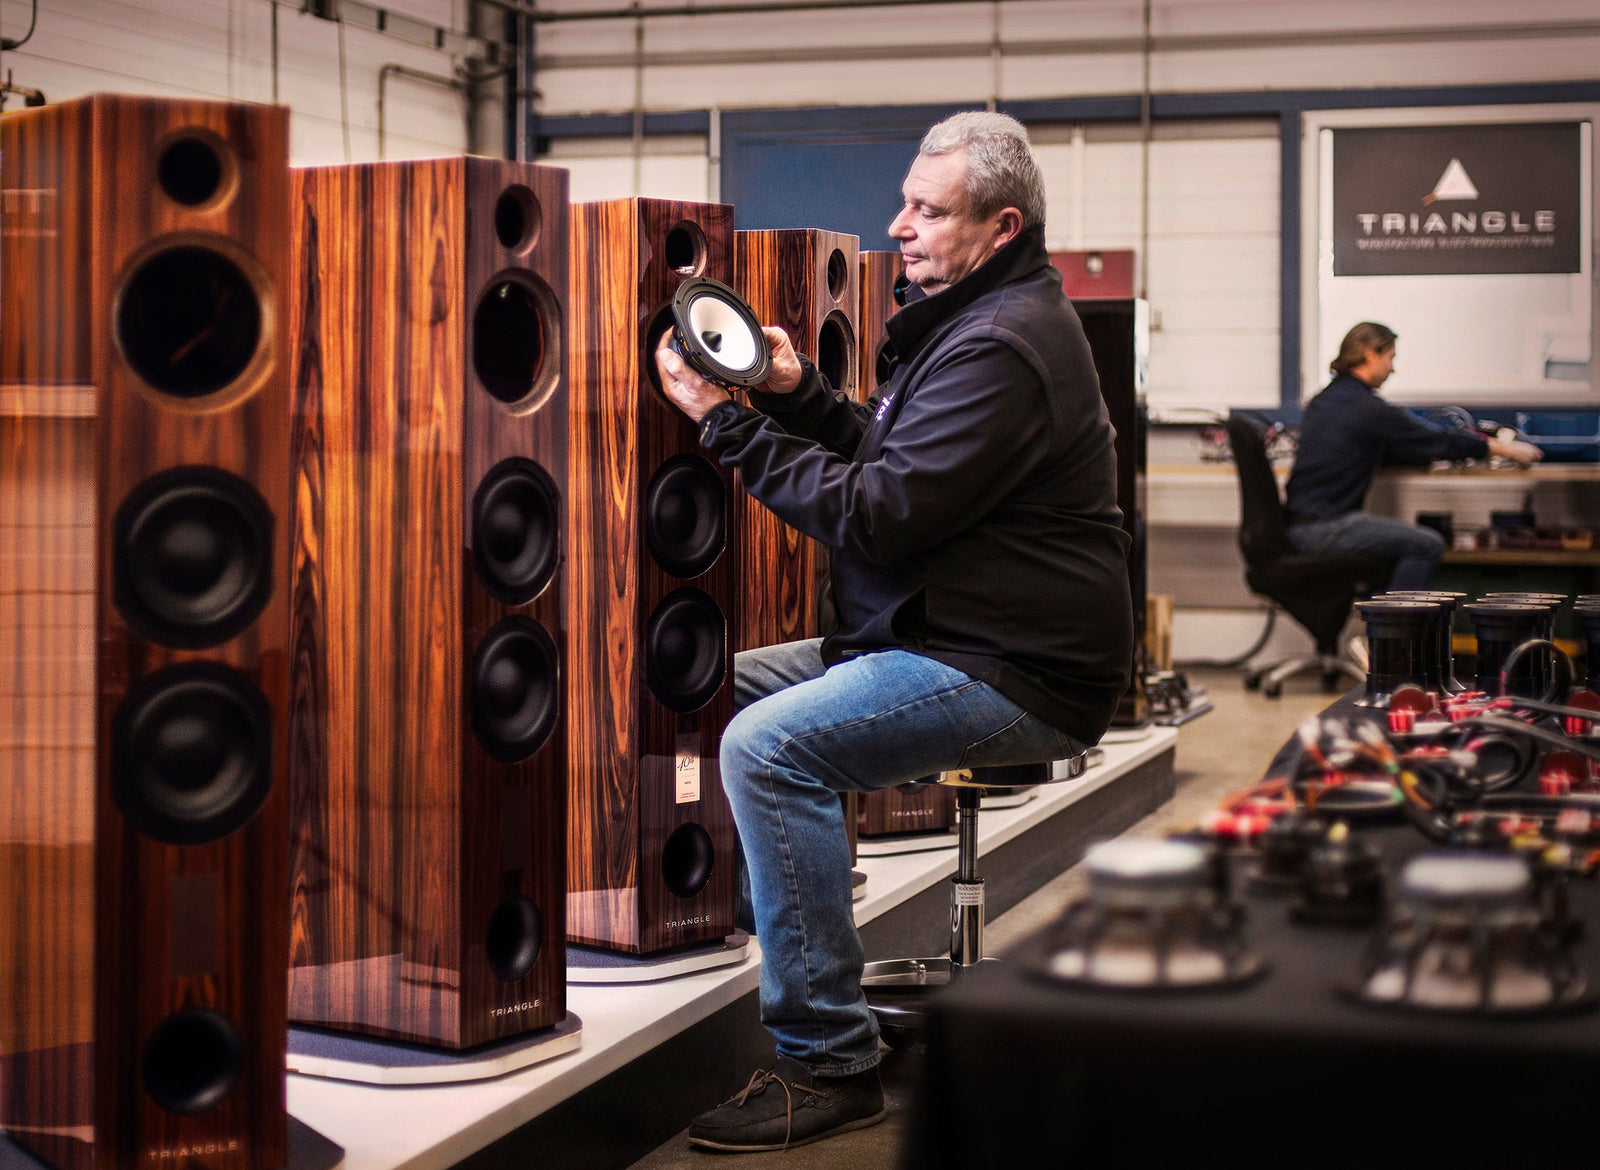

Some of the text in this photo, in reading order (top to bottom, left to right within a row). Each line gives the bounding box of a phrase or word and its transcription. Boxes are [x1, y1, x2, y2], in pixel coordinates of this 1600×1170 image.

[1355, 210, 1556, 235] TRIANGLE
[891, 808, 934, 818] TRIANGLE
[665, 914, 711, 929] TRIANGLE
[489, 999, 540, 1018] TRIANGLE
[148, 1140, 238, 1160] TRIANGLE
